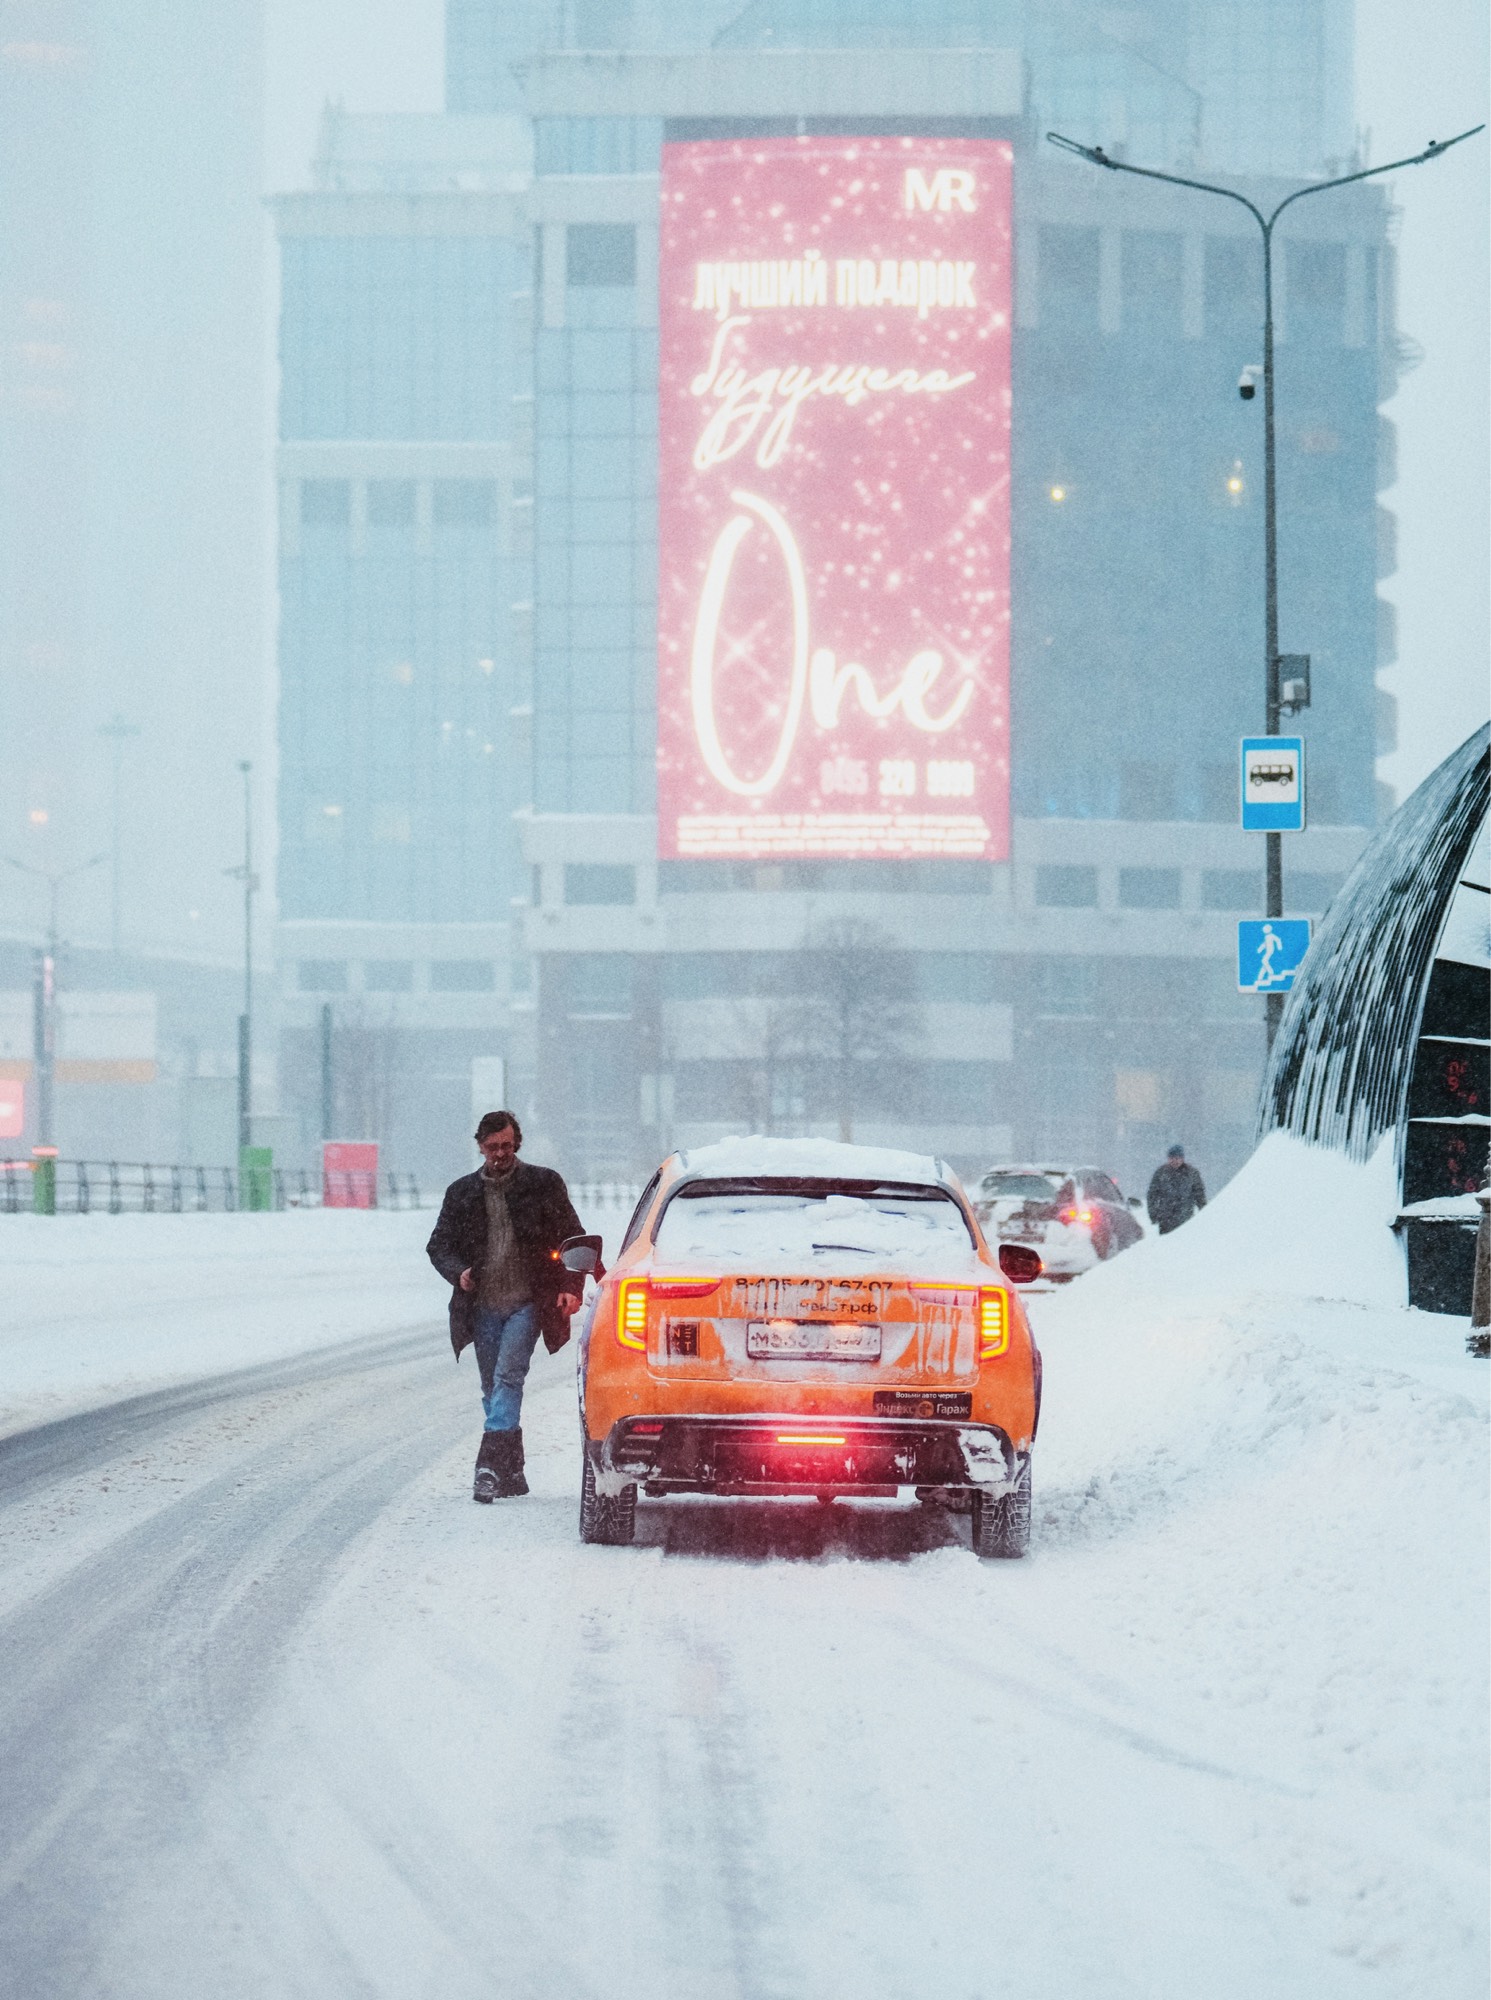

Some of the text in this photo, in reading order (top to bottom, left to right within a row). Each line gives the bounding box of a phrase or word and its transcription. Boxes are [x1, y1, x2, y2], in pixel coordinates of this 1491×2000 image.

[904, 168, 977, 212] MR
[690, 489, 975, 796] One
[875, 1403, 970, 1415] Яндекс Гараж
[895, 1391, 921, 1399] Возьми
